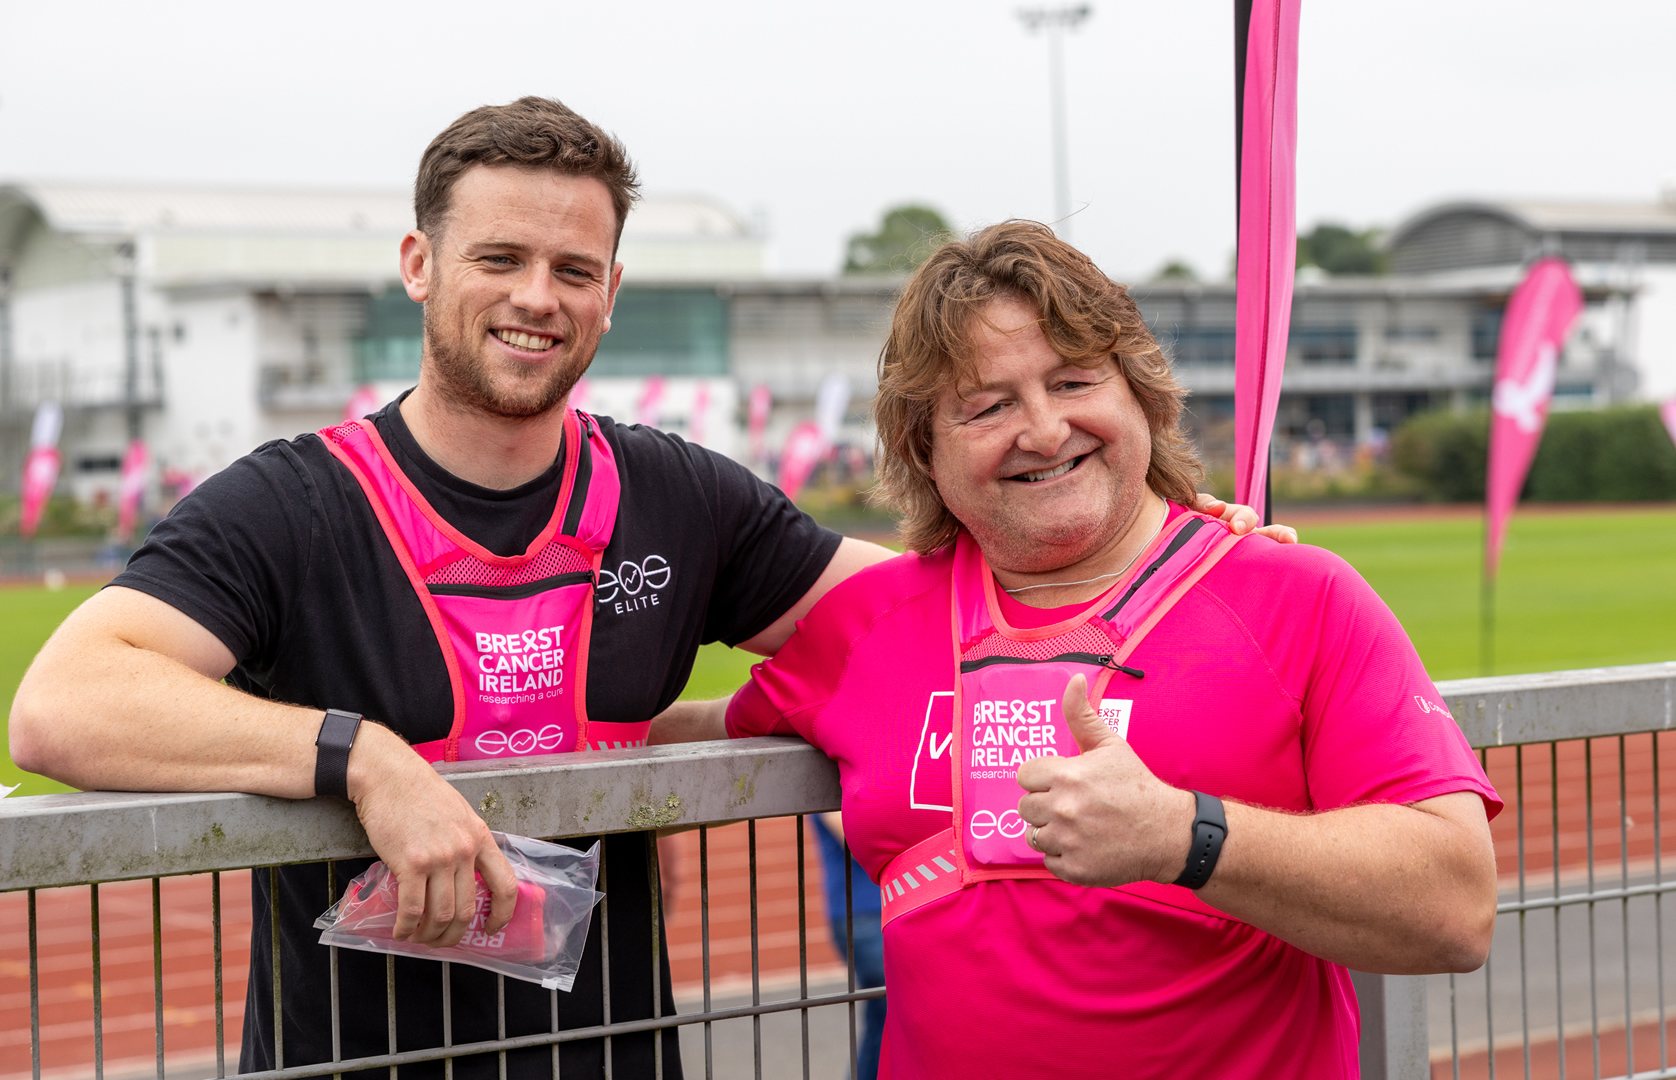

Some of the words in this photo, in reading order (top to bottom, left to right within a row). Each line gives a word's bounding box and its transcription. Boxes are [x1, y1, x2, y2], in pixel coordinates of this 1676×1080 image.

[615, 594, 660, 614] ELITE
[475, 625, 564, 654] BREAST
[478, 649, 564, 674] CANCER
[479, 669, 563, 693] IRELAND
[479, 693, 535, 704] researching
[538, 692, 544, 700] a
[546, 687, 564, 698] cure
[973, 699, 1057, 725] BREAST
[475, 724, 564, 755] eos
[972, 725, 1057, 747] CANCER
[970, 769, 1018, 779] researchin
[970, 809, 1031, 839] eo
